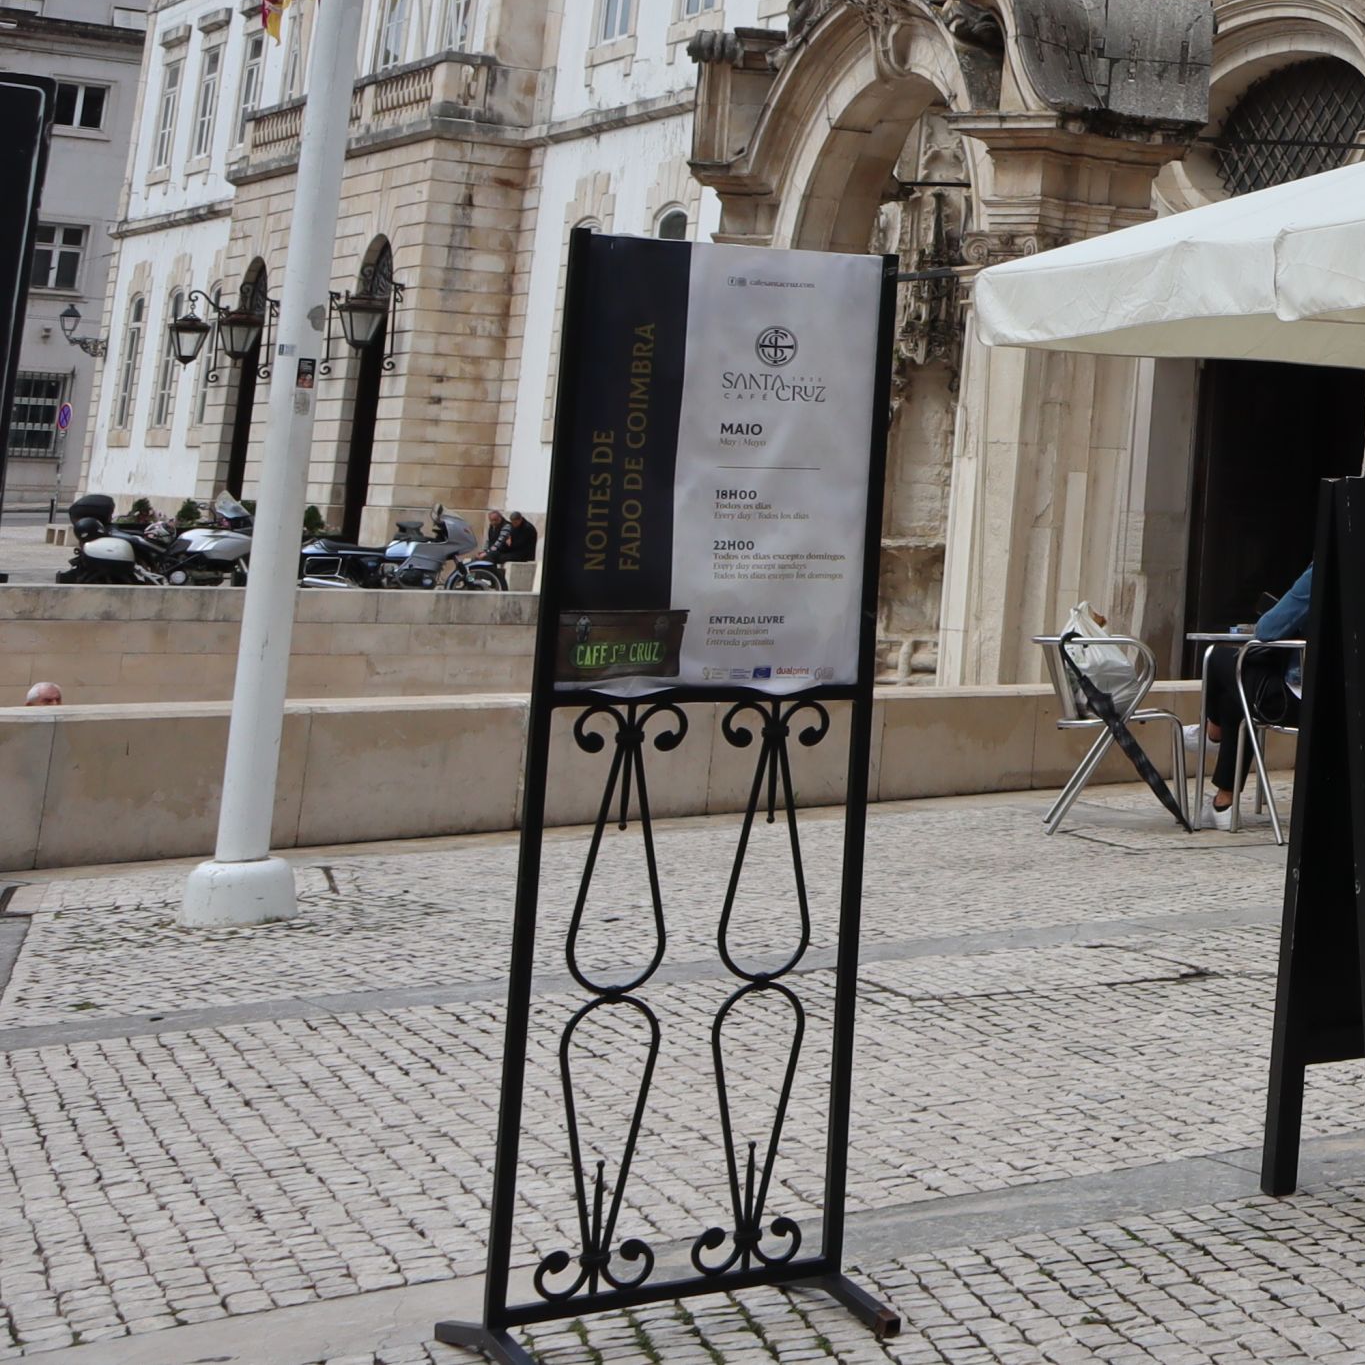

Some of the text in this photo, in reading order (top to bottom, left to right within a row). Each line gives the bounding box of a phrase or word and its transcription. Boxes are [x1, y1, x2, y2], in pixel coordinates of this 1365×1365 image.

[722, 372, 826, 402] SANTA CRUZ
[720, 423, 763, 435] MAIO
[618, 322, 656, 571] FADO DE COIMBRA
[583, 430, 615, 571] NOITES DE
[715, 490, 757, 500] 18H00
[713, 540, 755, 551] 22H00
[708, 615, 785, 625] ENTRADA LIVRE
[629, 641, 660, 662] CRUZ
